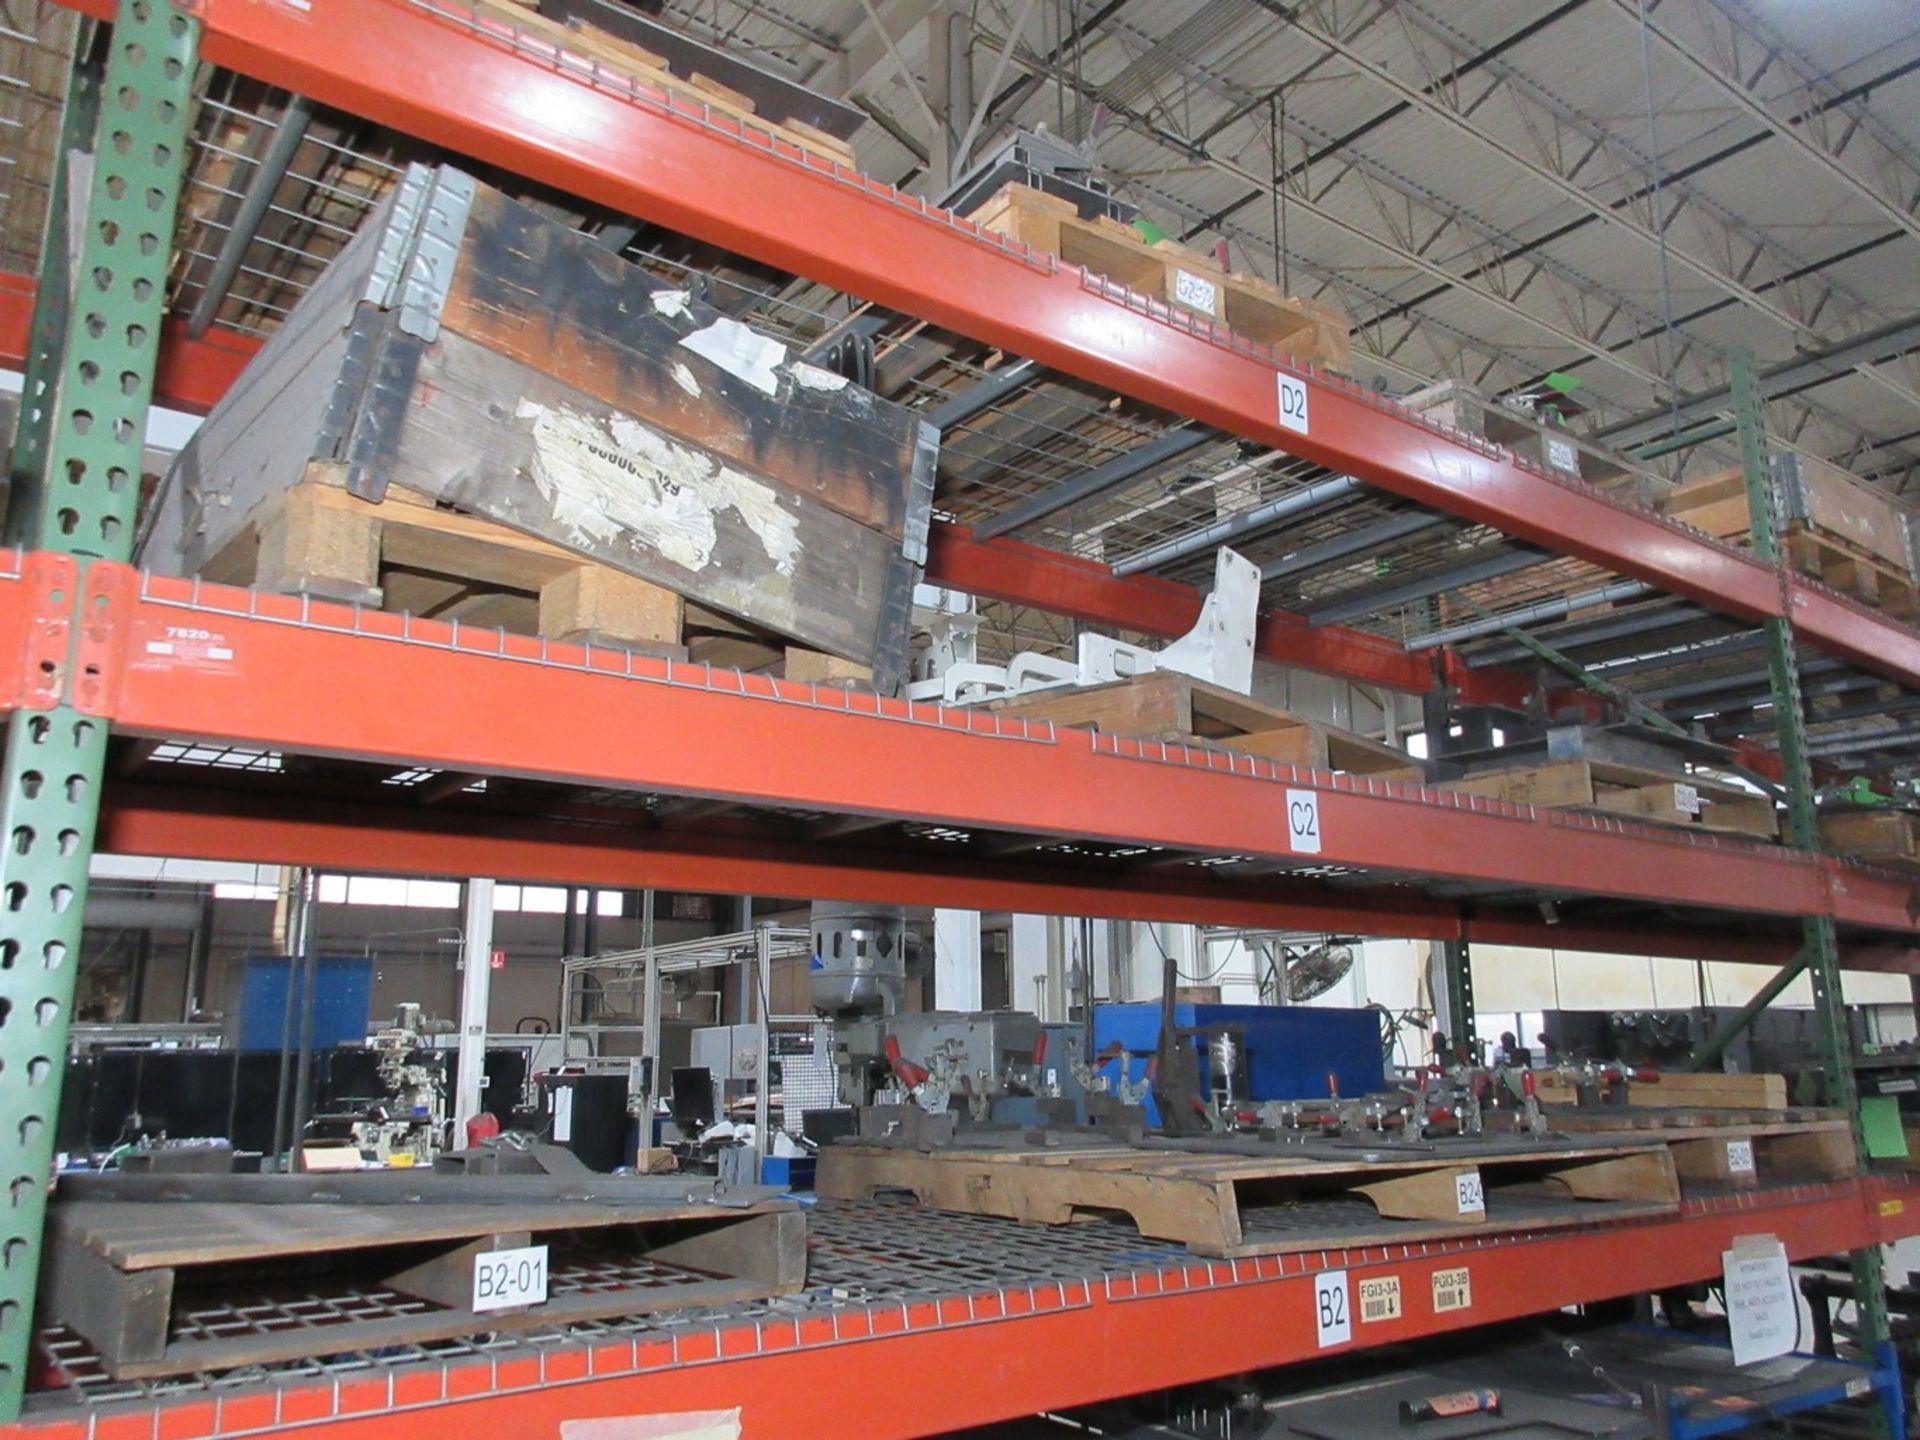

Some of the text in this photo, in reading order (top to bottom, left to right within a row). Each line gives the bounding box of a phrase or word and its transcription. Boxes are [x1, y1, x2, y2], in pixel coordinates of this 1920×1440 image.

[1281, 383, 1306, 420] D2
[165, 625, 209, 641] 7820
[1290, 801, 1316, 836] C2
[478, 1259, 541, 1298] B2-01
[1360, 1280, 1399, 1299] FGI3-3A
[1319, 1285, 1346, 1329] B2
